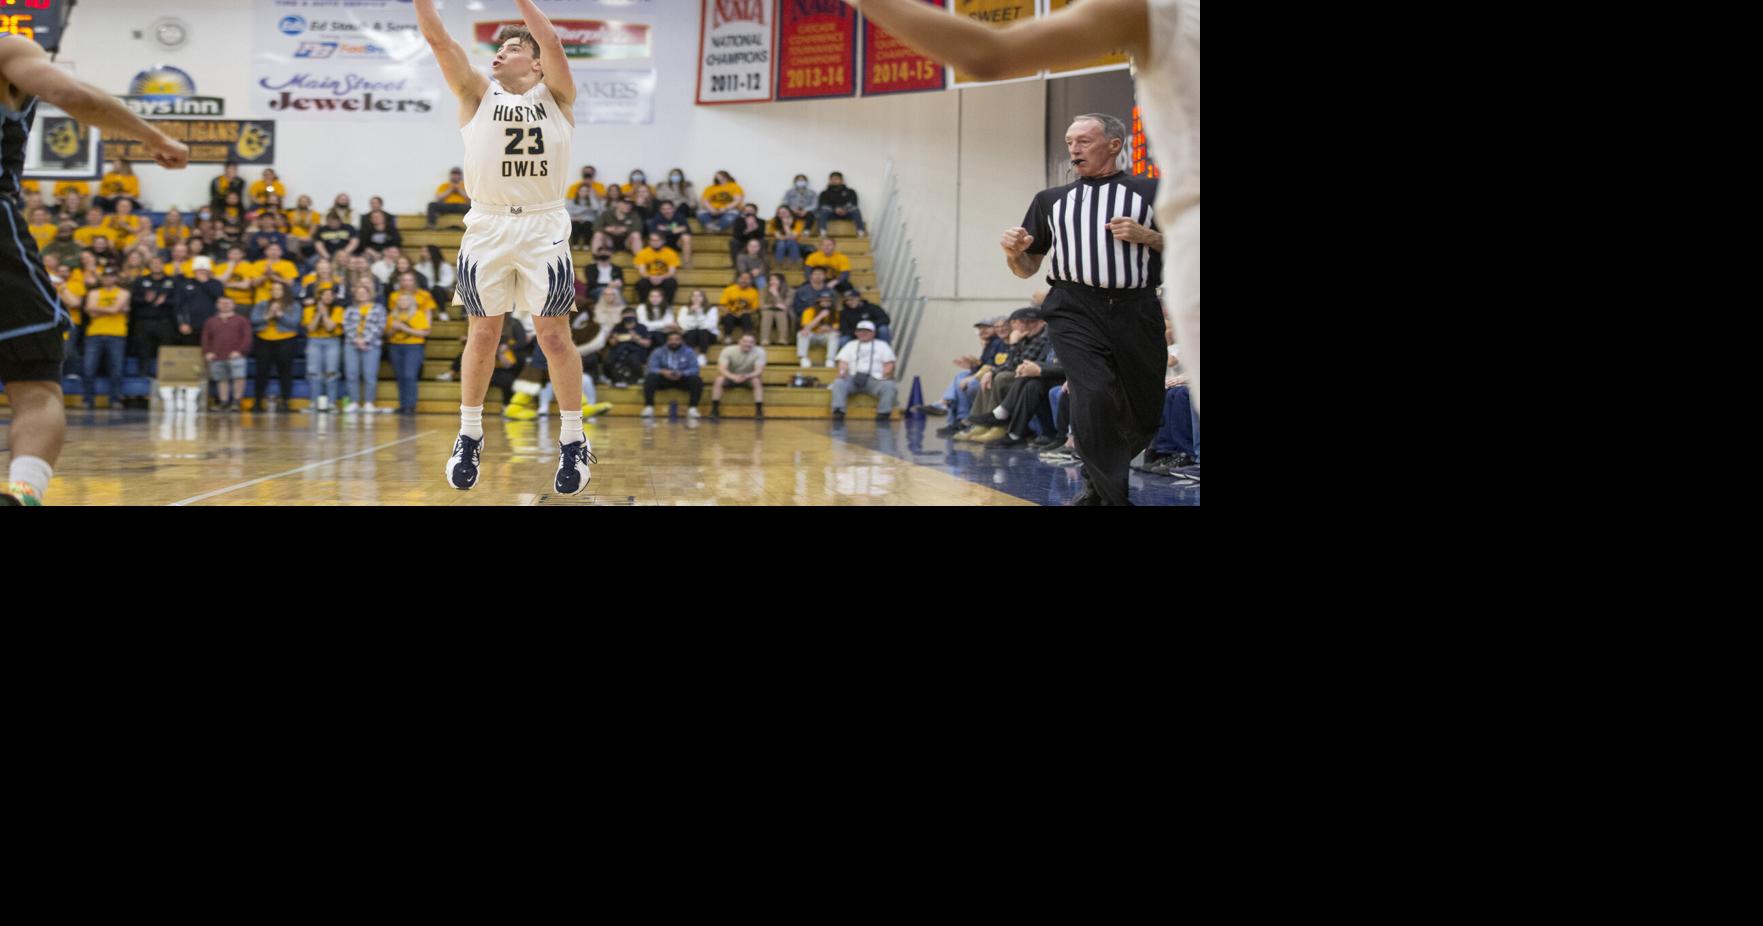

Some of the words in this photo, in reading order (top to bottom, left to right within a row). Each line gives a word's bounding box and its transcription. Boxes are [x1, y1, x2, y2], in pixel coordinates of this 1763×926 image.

[711, 34, 763, 47] NATIONAL
[706, 50, 768, 66] CHAMPIONS
[787, 66, 844, 88] 2013-14
[872, 61, 935, 84] 2014-15
[579, 82, 638, 98] AKES
[710, 73, 761, 92] 2011-12
[127, 100, 173, 115] ays
[174, 98, 220, 114] Inn
[269, 92, 432, 112] Jewelers
[504, 126, 545, 155] 23
[502, 160, 548, 177] OWLS
